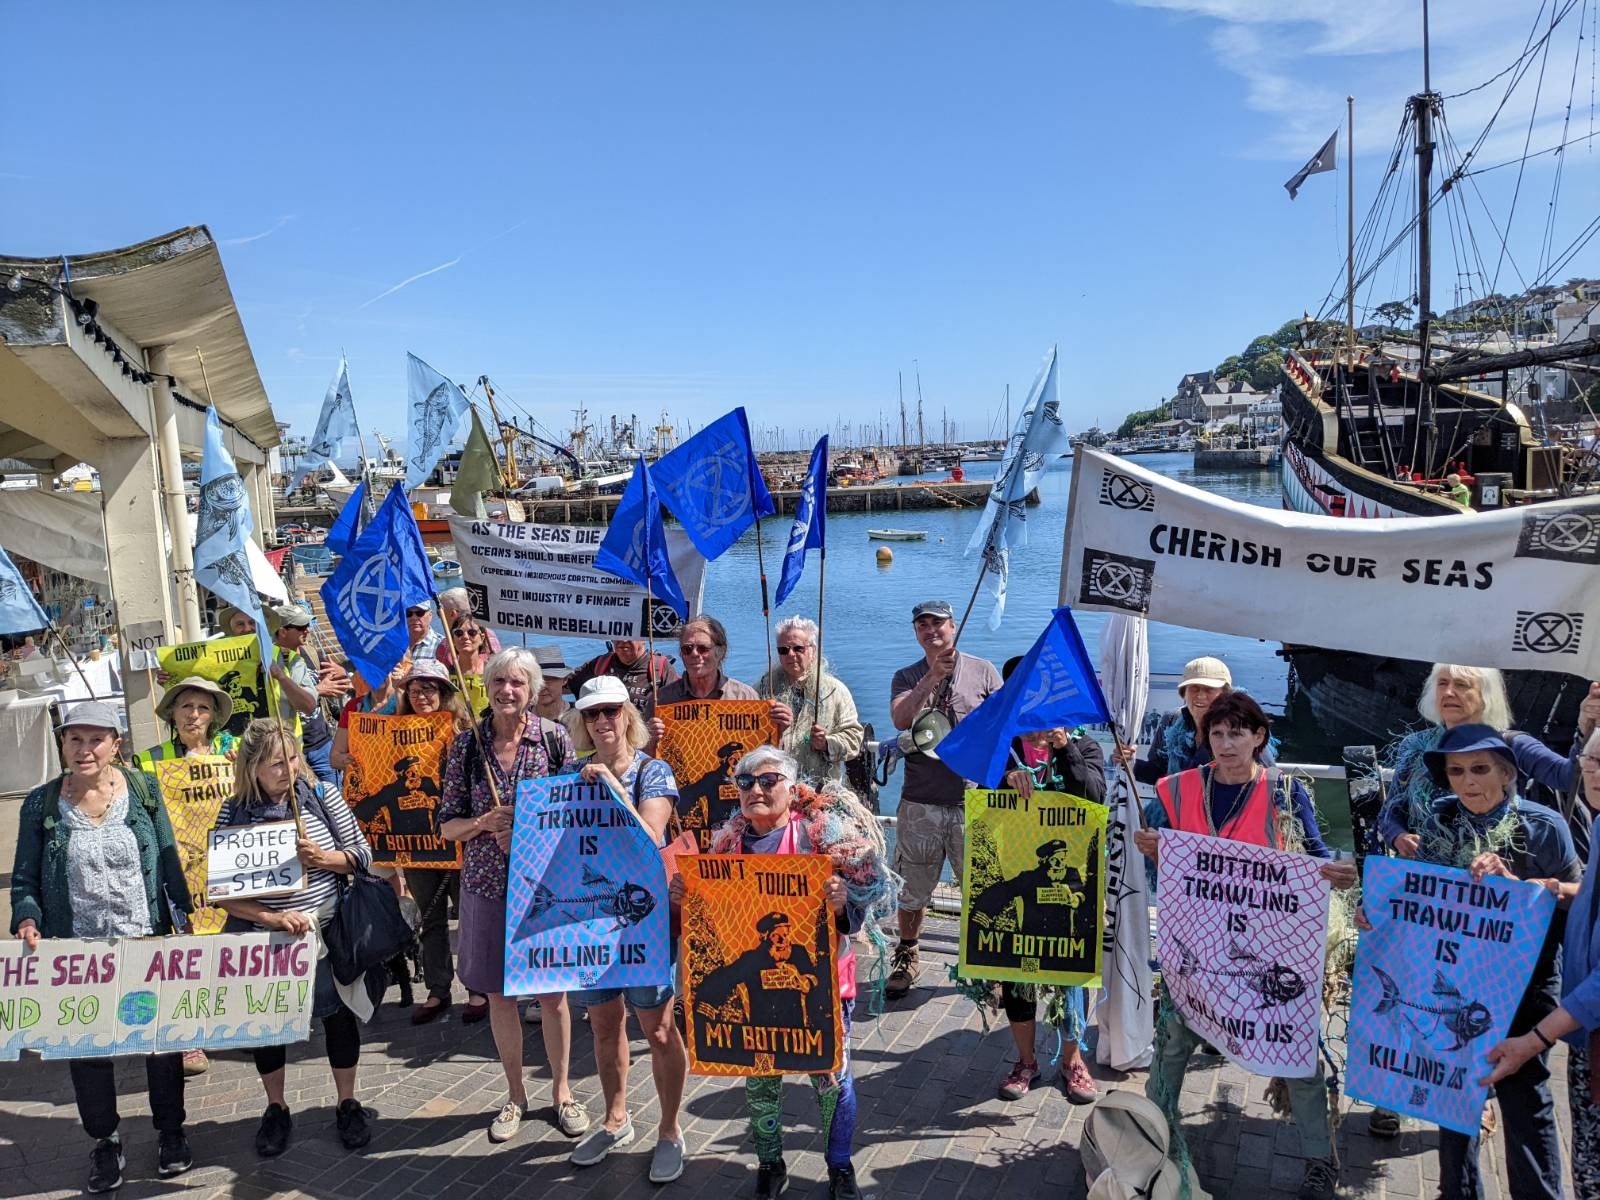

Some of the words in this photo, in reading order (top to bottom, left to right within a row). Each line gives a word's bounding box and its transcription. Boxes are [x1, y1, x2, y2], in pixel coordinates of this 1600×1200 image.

[471, 521, 491, 536] AS
[497, 523, 526, 540] THE
[531, 527, 571, 543] SEAS
[471, 545, 512, 558] OCEANS
[514, 550, 554, 562] SHOULD
[557, 553, 595, 565] BENEFI
[1149, 524, 1282, 568] CHERISH
[1306, 553, 1377, 580] OUR
[1402, 558, 1493, 591] SEAS
[500, 589, 520, 600] NOT
[522, 591, 573, 604] INDUSTRY
[586, 595, 631, 608] FINANCE
[497, 611, 543, 630] OCEAN
[549, 617, 634, 637] REBELLION
[131, 635, 164, 652] NOT
[175, 644, 207, 662] DON'T
[215, 646, 252, 664] TOUCH
[674, 703, 711, 721] DON'T
[717, 713, 760, 731] TOUCH
[359, 717, 387, 736] DON'T
[391, 726, 435, 747] TOUCH
[189, 762, 231, 782] BOTT
[181, 783, 232, 804] TRAW
[549, 781, 614, 804] BOTTO
[1038, 807, 1087, 826] TOUCH
[386, 834, 447, 851] BOTTOM
[579, 835, 598, 856] IS
[235, 850, 280, 869] OUR
[1196, 851, 1288, 886] BOTTOM
[232, 867, 292, 892] SEAS
[698, 859, 745, 883] DON'T
[755, 871, 809, 898] TOUCH
[1183, 876, 1300, 915] TRAWLING
[1405, 871, 1511, 913] BOTTOM
[1226, 912, 1248, 933] IS
[1389, 898, 1514, 944] TRAWLING
[528, 944, 611, 969] KILLING
[620, 943, 647, 966] US
[978, 931, 1003, 953] MY
[1012, 934, 1085, 959] BOTTOM
[1434, 938, 1460, 965] IS
[51, 953, 116, 987] SEAS
[145, 948, 203, 983] ARE
[218, 943, 310, 979] RISING
[0, 997, 41, 1032] ND
[57, 995, 100, 1027] SO
[172, 986, 228, 1020] ARE
[245, 980, 309, 1014] WE!
[706, 1022, 733, 1049] MY
[742, 1026, 823, 1057] BOTTOM
[1265, 1022, 1294, 1044] US
[1369, 1042, 1446, 1087] KILLING
